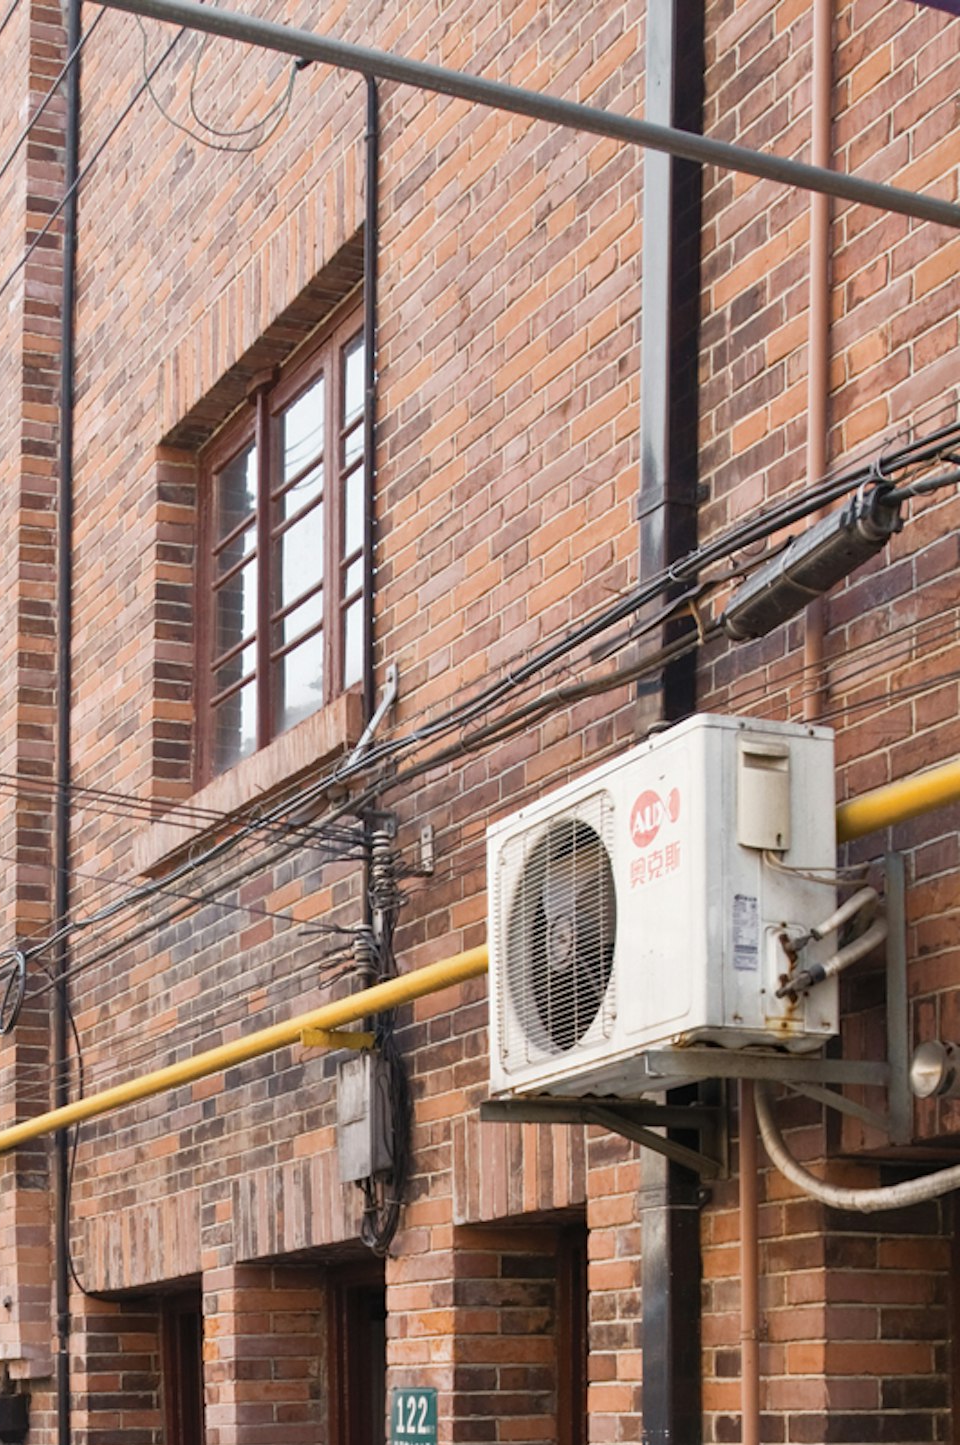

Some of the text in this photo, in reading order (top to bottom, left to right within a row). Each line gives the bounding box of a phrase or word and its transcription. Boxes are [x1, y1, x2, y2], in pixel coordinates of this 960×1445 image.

[630, 840, 681, 889] 奥克斯
[396, 1395, 428, 1434] 122
